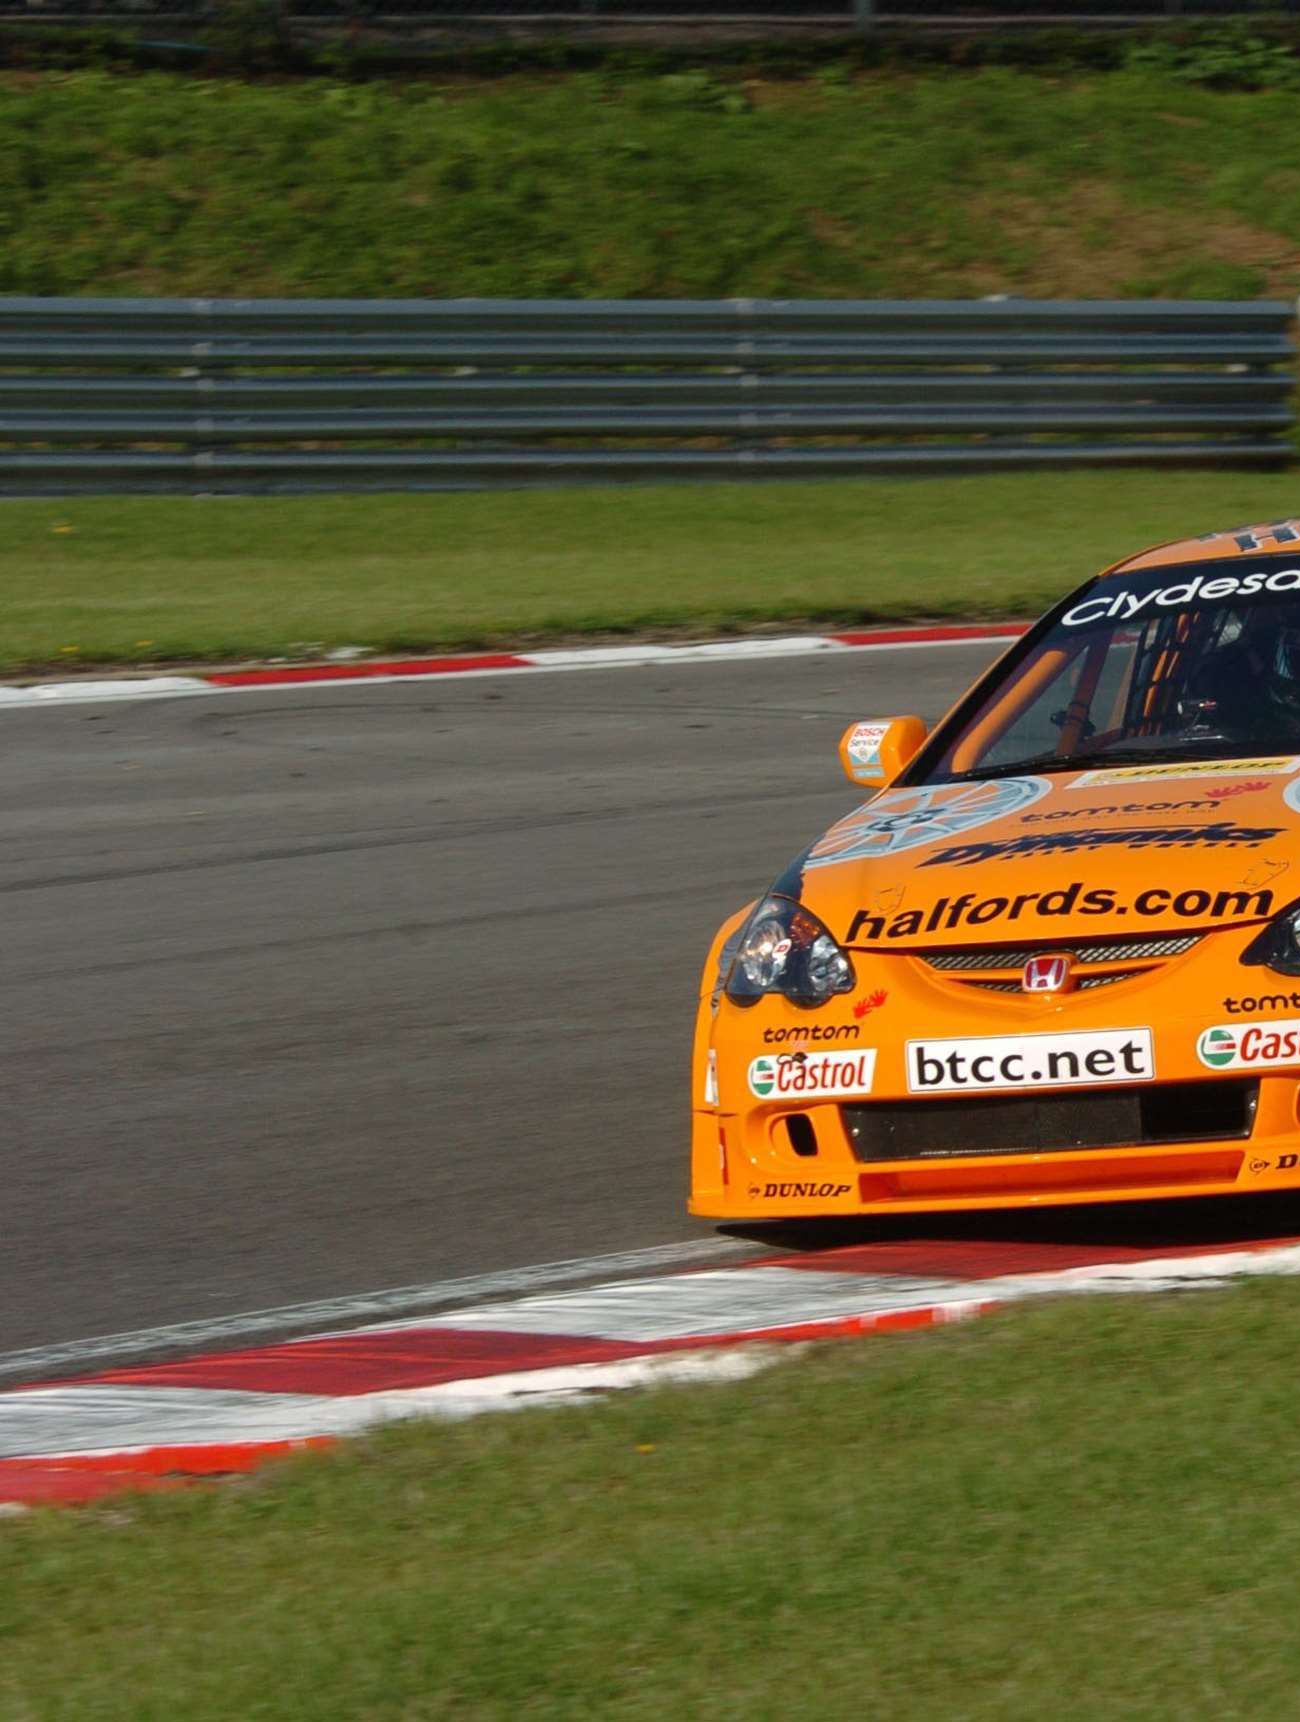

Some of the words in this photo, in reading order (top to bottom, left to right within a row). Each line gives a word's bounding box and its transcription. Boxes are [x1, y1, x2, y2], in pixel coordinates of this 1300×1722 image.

[1019, 798, 1221, 824] tomtom
[844, 882, 1275, 944] halfords.com
[763, 1024, 860, 1044] tomtom
[776, 1054, 867, 1092] Castrol
[916, 1038, 1147, 1086] btcc.net
[763, 1182, 853, 1199] DUNLOP
